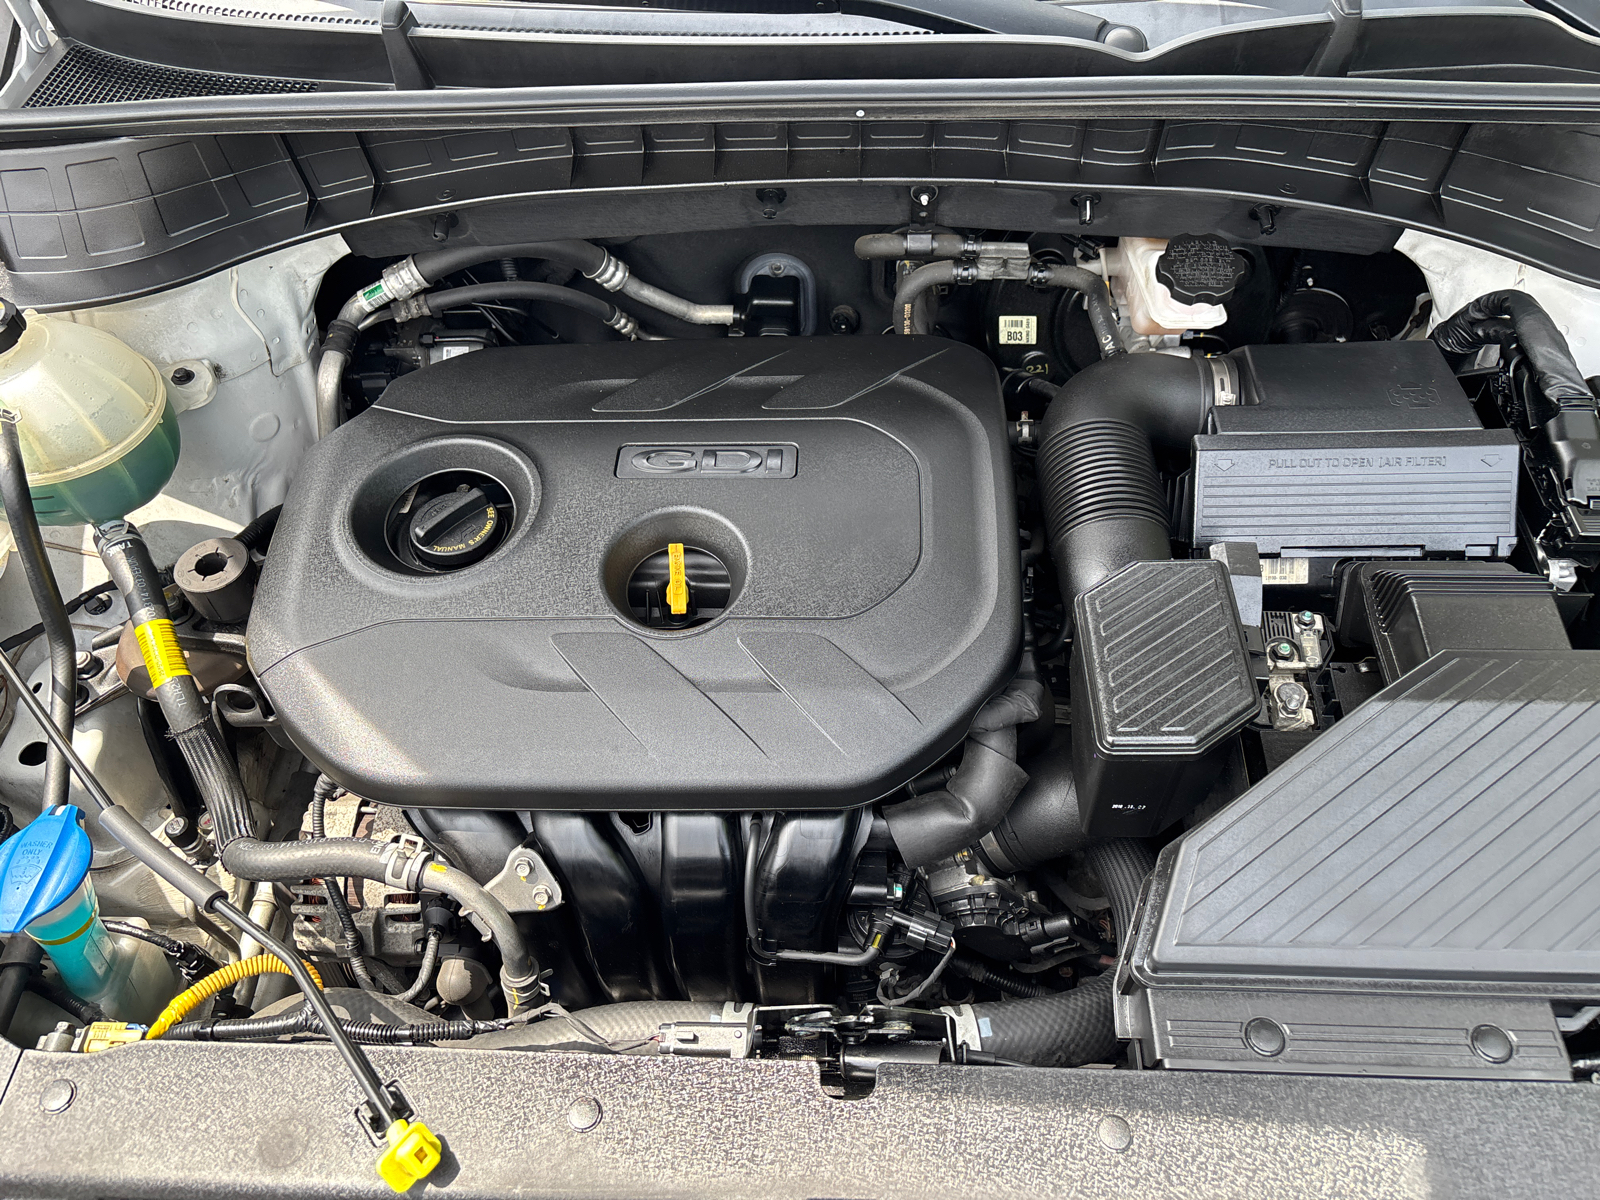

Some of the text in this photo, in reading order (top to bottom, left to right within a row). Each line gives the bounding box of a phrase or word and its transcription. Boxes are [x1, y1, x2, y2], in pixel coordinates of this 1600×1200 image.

[1007, 330, 1023, 342] B03
[1026, 363, 1049, 375] 221
[631, 448, 784, 474] GDI
[1268, 458, 1297, 469] PULL
[1299, 458, 1322, 468] OUT
[1325, 458, 1340, 468] TO
[1342, 457, 1374, 468] OPEN
[432, 506, 495, 552] SEE OWNER'S MANUAL
[106, 540, 134, 557] TANK
[20, 840, 54, 849] WASHER
[21, 848, 43, 856] ONLY
